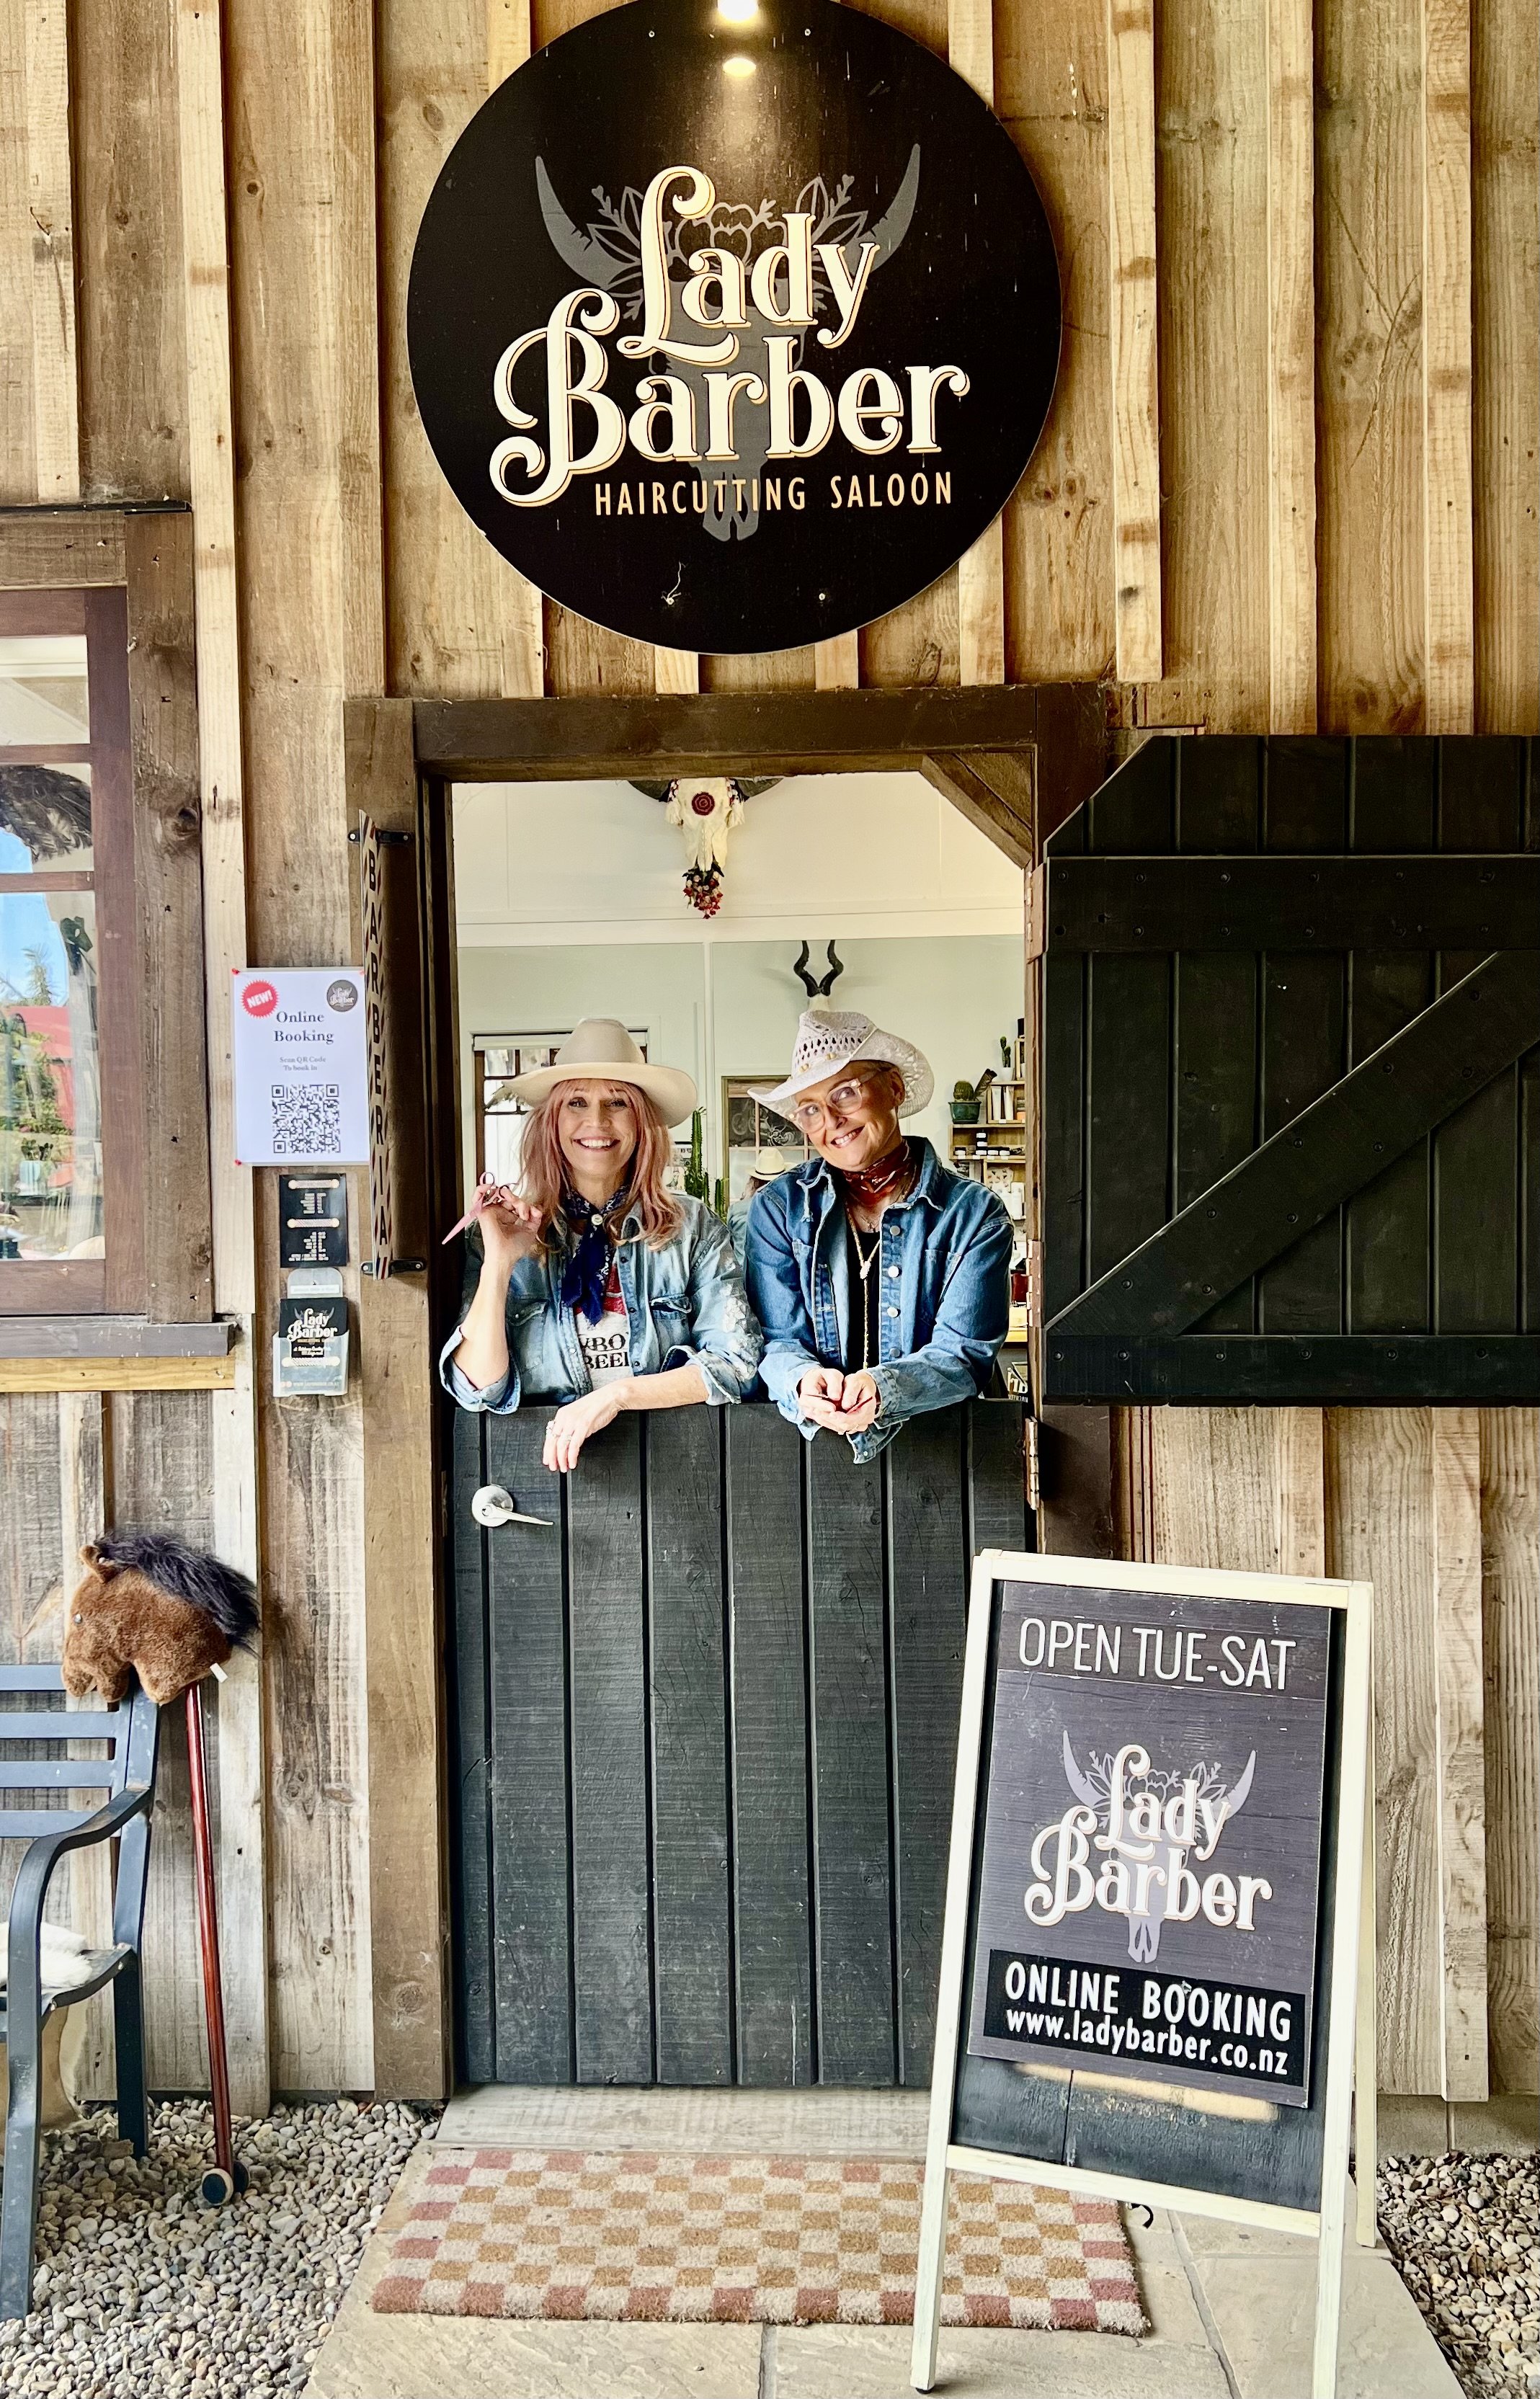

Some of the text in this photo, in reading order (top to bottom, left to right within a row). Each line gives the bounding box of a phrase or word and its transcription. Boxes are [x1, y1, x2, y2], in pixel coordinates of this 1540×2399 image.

[617, 165, 880, 365] Lady
[489, 288, 971, 507] Barber
[596, 472, 952, 516] HAIRCUTTING SALOON
[246, 989, 272, 1008] NEW!
[276, 1011, 324, 1023] Online
[273, 1030, 334, 1044] Booking
[369, 848, 387, 1245] BARBERIA
[302, 1308, 329, 1328] Lady
[1019, 1617, 1296, 1691] OPEN TUE-SAT
[1094, 1744, 1231, 1861] Lady
[1024, 1805, 1273, 1931] Barber
[1005, 1961, 1291, 2042] ONLINE BOOKING
[1006, 2008, 1288, 2075] www.ladybarber.co.nz
